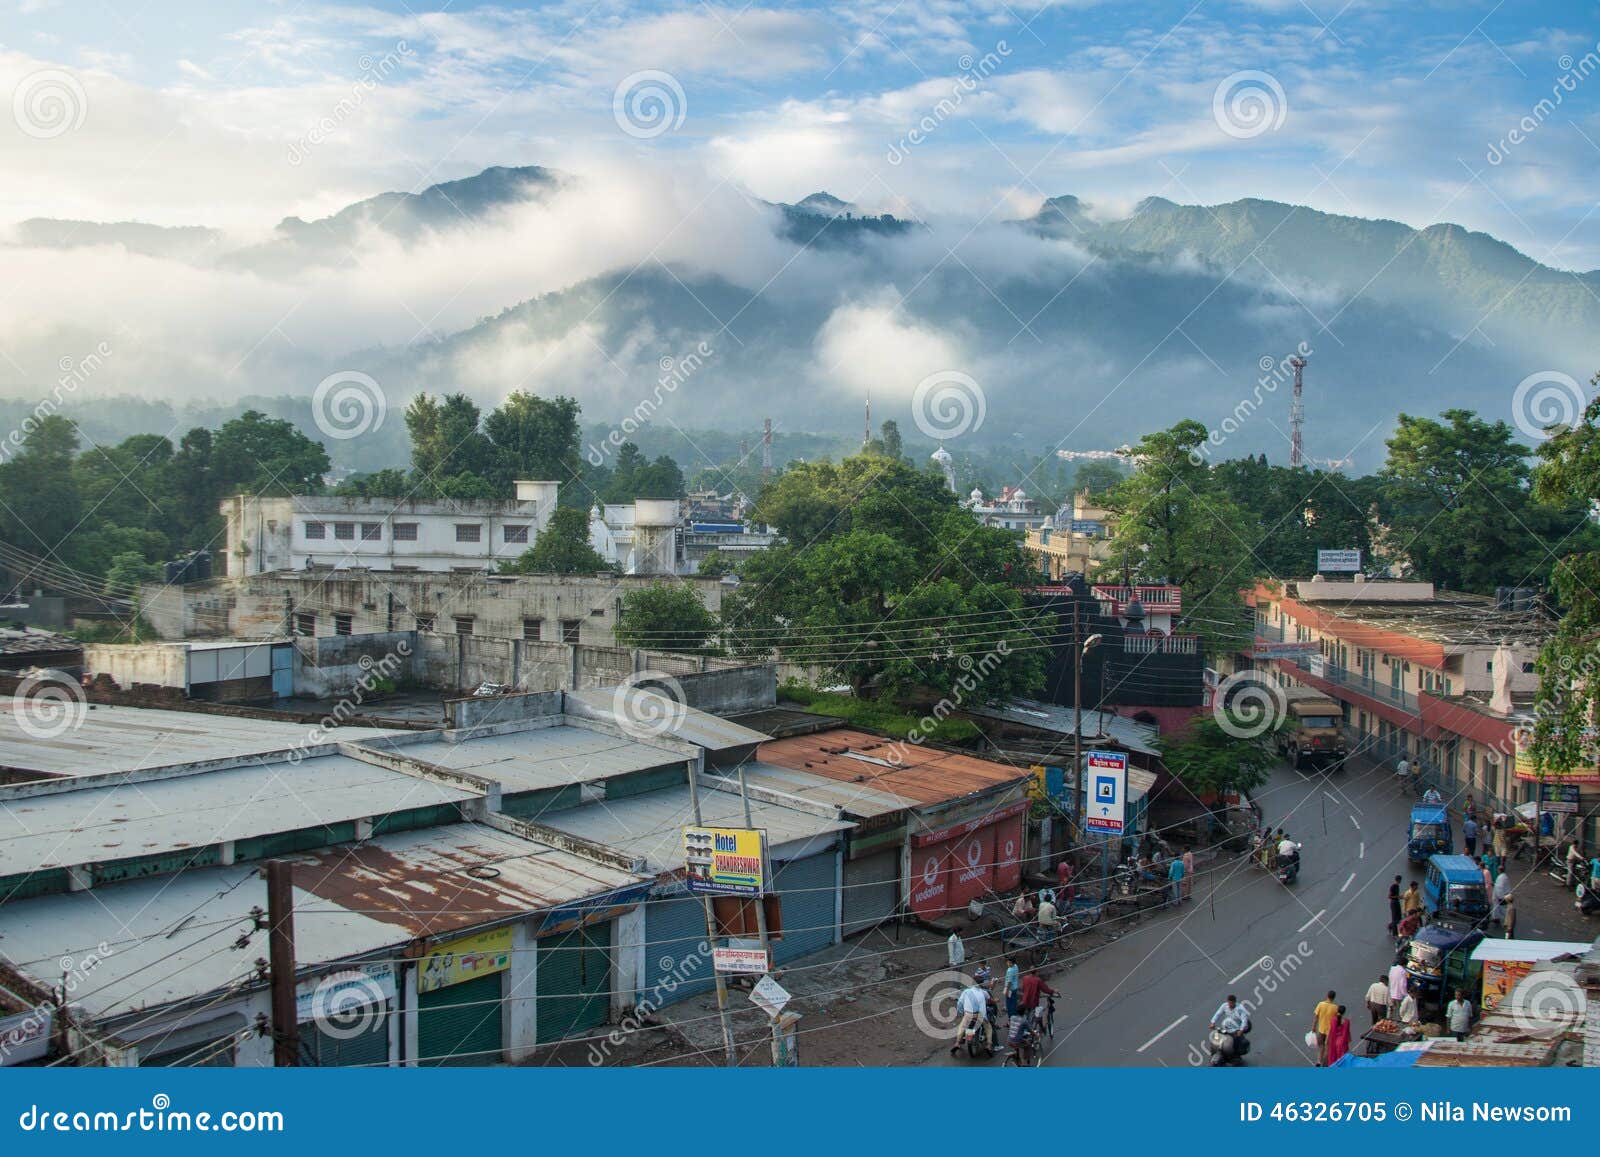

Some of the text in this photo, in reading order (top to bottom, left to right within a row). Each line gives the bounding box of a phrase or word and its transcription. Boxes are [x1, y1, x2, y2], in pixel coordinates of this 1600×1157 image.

[1088, 817, 1108, 827] PETROL
[714, 832, 737, 853] Hotel
[715, 854, 760, 876] CHANDRESHWAR
[915, 884, 945, 903] vodafone
